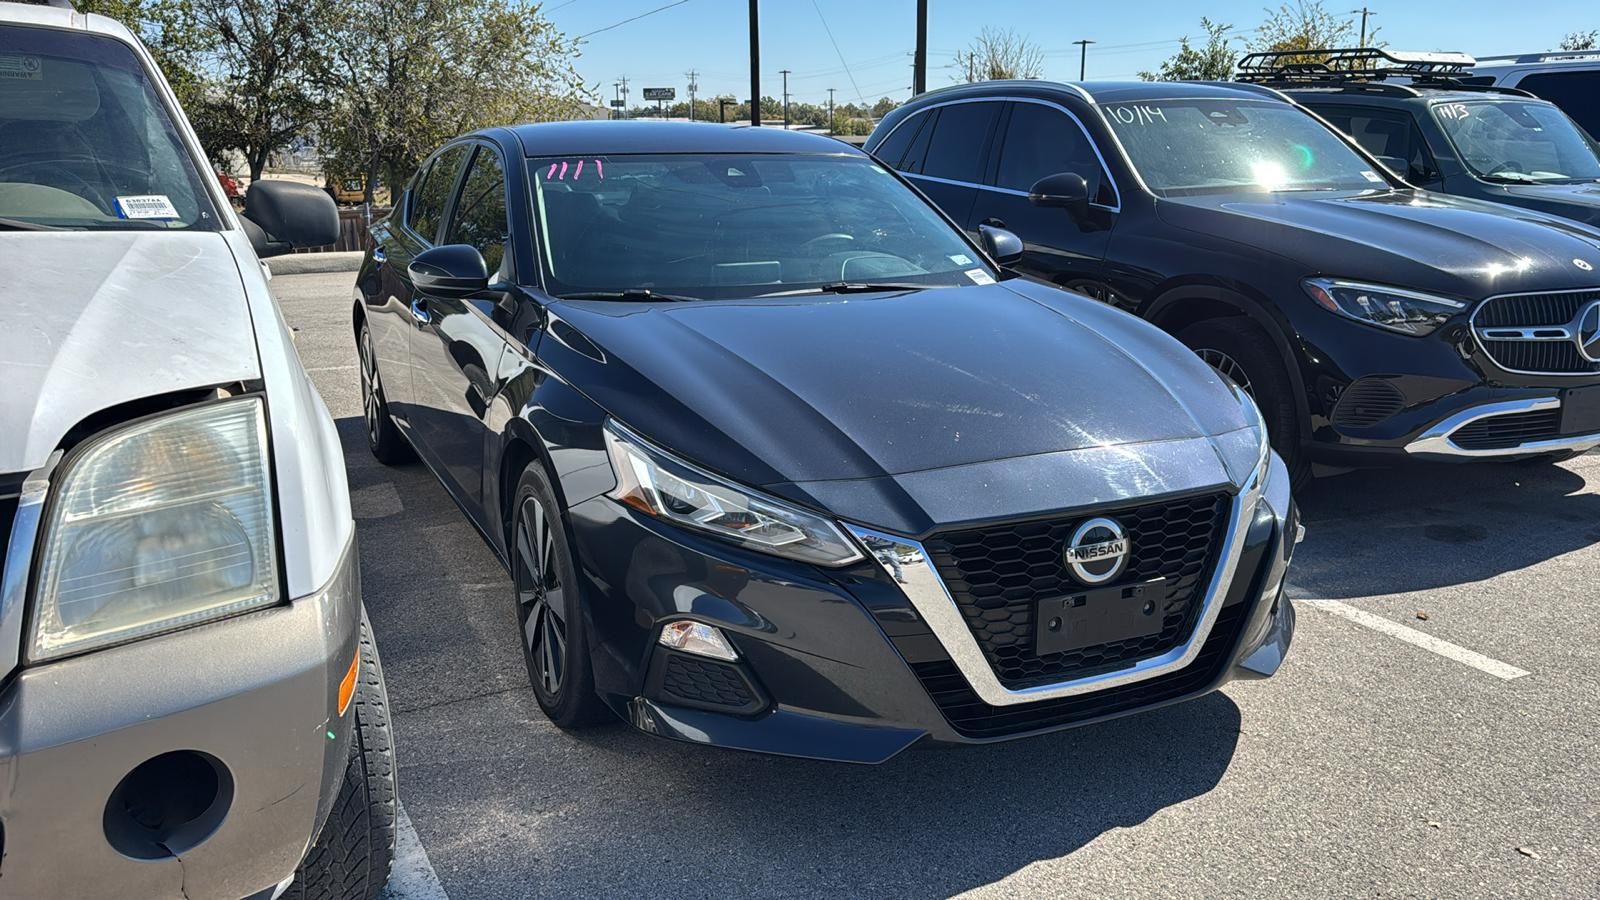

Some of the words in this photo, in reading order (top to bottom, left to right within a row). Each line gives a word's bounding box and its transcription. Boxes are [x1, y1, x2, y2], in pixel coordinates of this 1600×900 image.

[1106, 105, 1167, 125] 10/14
[1440, 104, 1469, 120] 11/3
[1074, 543, 1123, 559] NISSAN
